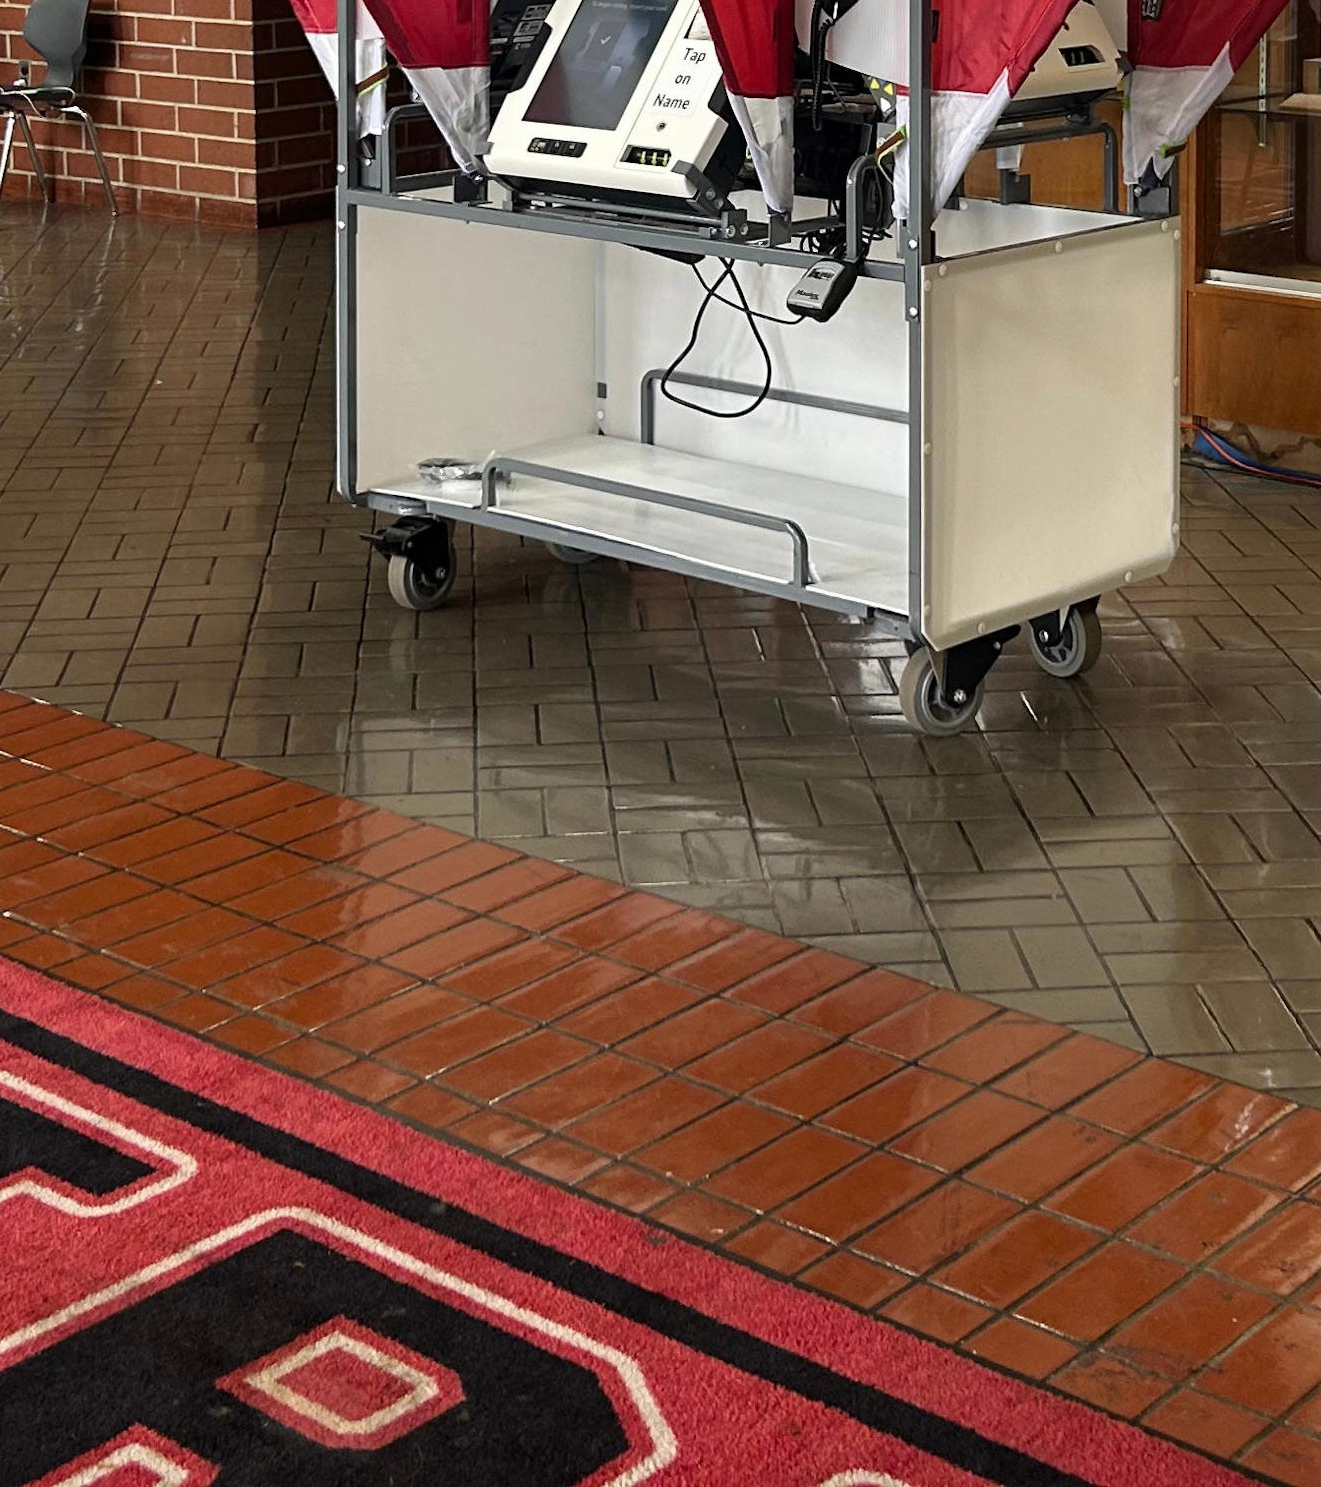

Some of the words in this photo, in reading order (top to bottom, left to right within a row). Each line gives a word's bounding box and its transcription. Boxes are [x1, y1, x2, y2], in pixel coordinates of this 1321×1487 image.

[683, 47, 707, 65] Tap
[674, 74, 692, 85] on
[652, 93, 691, 110] Name
